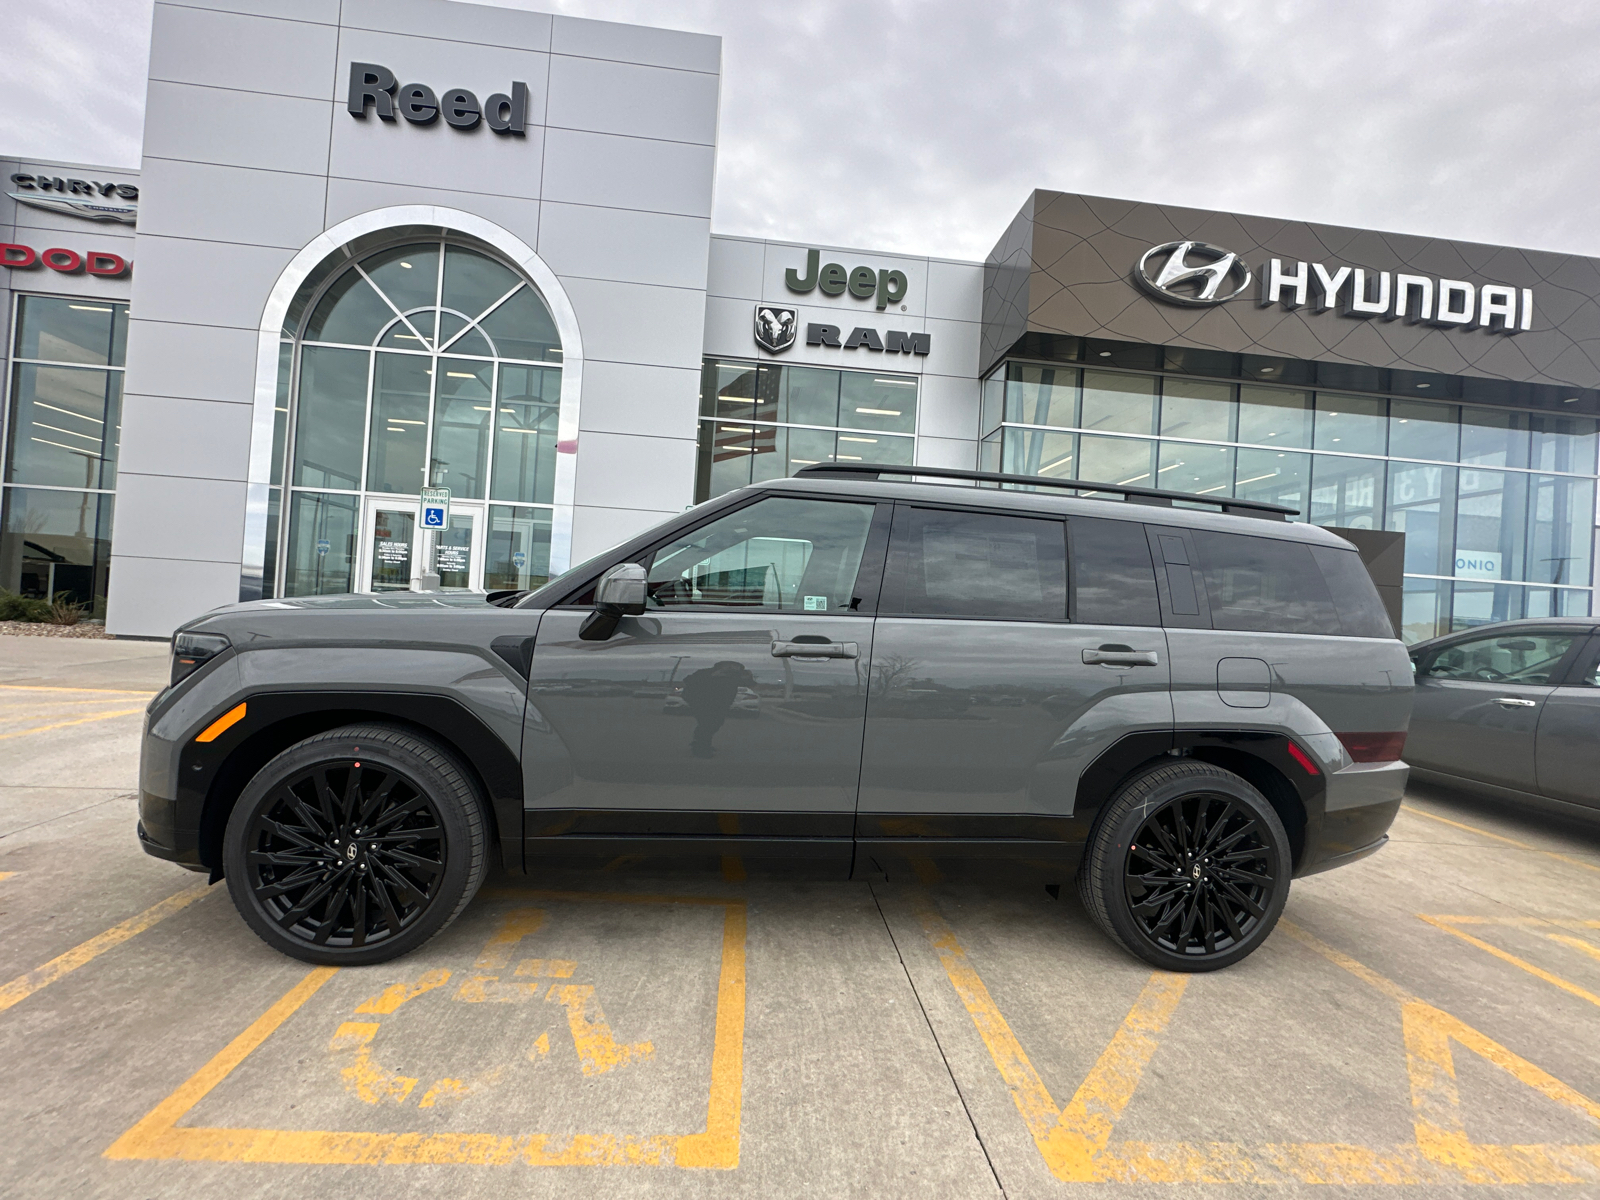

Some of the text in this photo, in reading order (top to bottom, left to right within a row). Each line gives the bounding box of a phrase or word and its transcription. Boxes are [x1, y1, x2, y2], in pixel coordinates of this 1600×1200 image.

[348, 61, 529, 137] Reed
[0, 243, 134, 275] DOD
[785, 249, 908, 310] Jeep
[1261, 258, 1533, 334] HYUNDAI
[807, 322, 931, 355] RAM
[424, 490, 448, 498] RESERVED
